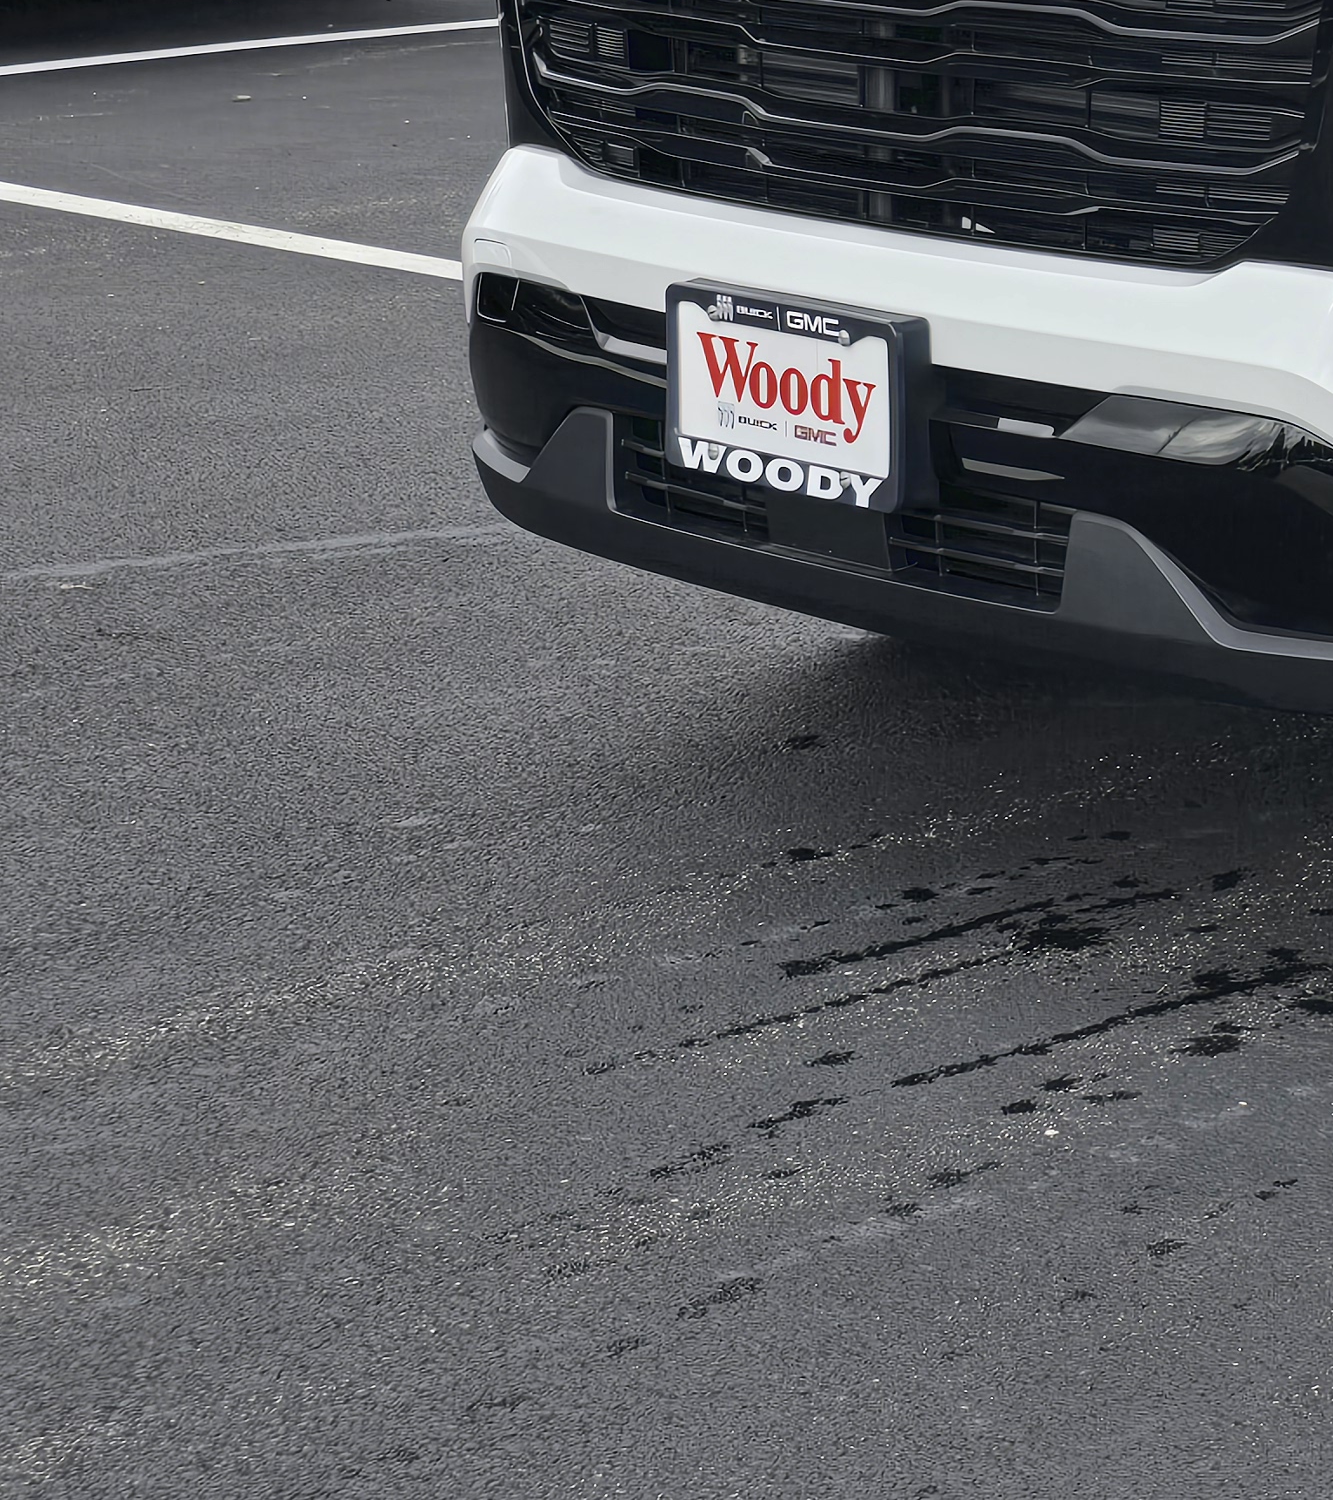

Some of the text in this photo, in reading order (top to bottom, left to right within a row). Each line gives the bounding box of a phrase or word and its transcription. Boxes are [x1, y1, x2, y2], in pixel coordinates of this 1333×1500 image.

[736, 304, 841, 337] BUICK GMC
[696, 331, 877, 444] Woody
[738, 415, 838, 447] BUICK GMC
[678, 436, 885, 509] WOODY
